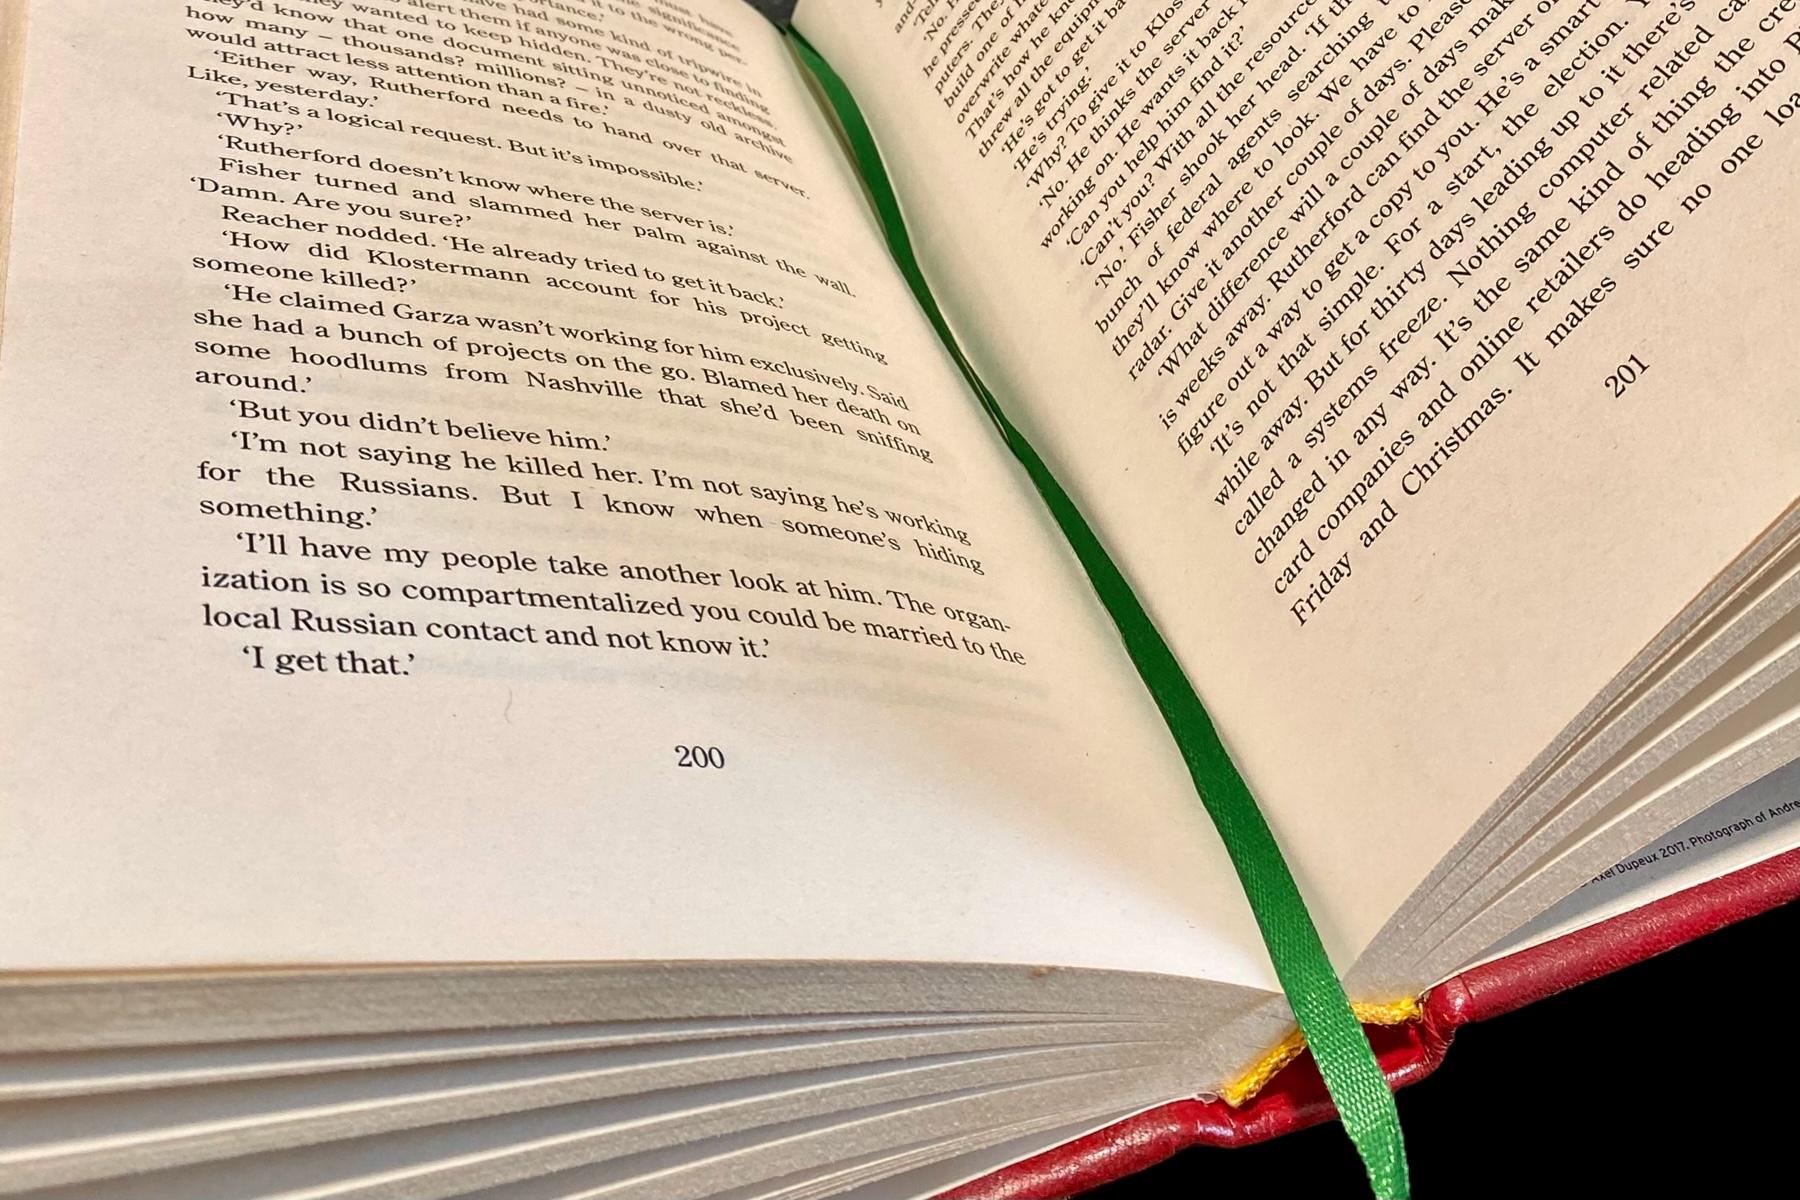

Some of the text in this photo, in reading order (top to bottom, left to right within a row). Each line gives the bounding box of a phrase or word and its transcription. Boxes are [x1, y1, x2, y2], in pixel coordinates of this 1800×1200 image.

[187, 65, 248, 88] Like,
[1034, 83, 1056, 117] got
[1055, 65, 1070, 84] to
[1071, 34, 1095, 67] get
[1091, 19, 1107, 35] it
[1065, 113, 1087, 135] To
[1088, 75, 1118, 115] give
[1115, 58, 1131, 75] it
[1129, 40, 1146, 58] to
[1098, 173, 1127, 212] you
[1123, 133, 1159, 174] help
[1155, 96, 1192, 134] him
[1189, 54, 1225, 96] find
[219, 156, 856, 298] Fisher turned and slammed her palm against the wall.
[292, 192, 340, 211] Are
[346, 202, 392, 218] you
[192, 256, 313, 282] someone
[1289, 551, 1352, 626] Friday
[1359, 498, 1398, 548] and
[1401, 387, 1512, 495] Christmas.
[1512, 351, 1540, 376] It
[1544, 276, 1616, 349] makes
[1623, 220, 1674, 269] sure
[1680, 183, 1711, 214] no
[1720, 134, 1763, 174] one
[1604, 353, 1650, 398] 201
[297, 410, 350, 427] you
[444, 418, 541, 445] believe
[298, 535, 371, 560] have
[383, 548, 429, 568] my
[441, 550, 537, 574] people
[547, 555, 608, 577] take
[619, 563, 722, 586] another
[728, 569, 788, 593] look
[795, 579, 820, 597] at
[824, 579, 882, 606] him.
[885, 589, 936, 615] The
[943, 606, 1011, 632] organ-
[201, 565, 1026, 665] ization is so compartmentalized you could be married to the
[202, 603, 281, 630] local
[290, 607, 417, 637] Russian
[425, 621, 538, 643] contact
[545, 625, 599, 647] and
[605, 631, 653, 650] not
[656, 629, 732, 655] know
[274, 651, 327, 675] get
[674, 745, 725, 769] 200
[1615, 853, 1660, 874] Dupeux
[1688, 818, 1754, 847] Photograph
[1754, 811, 1768, 824] of
